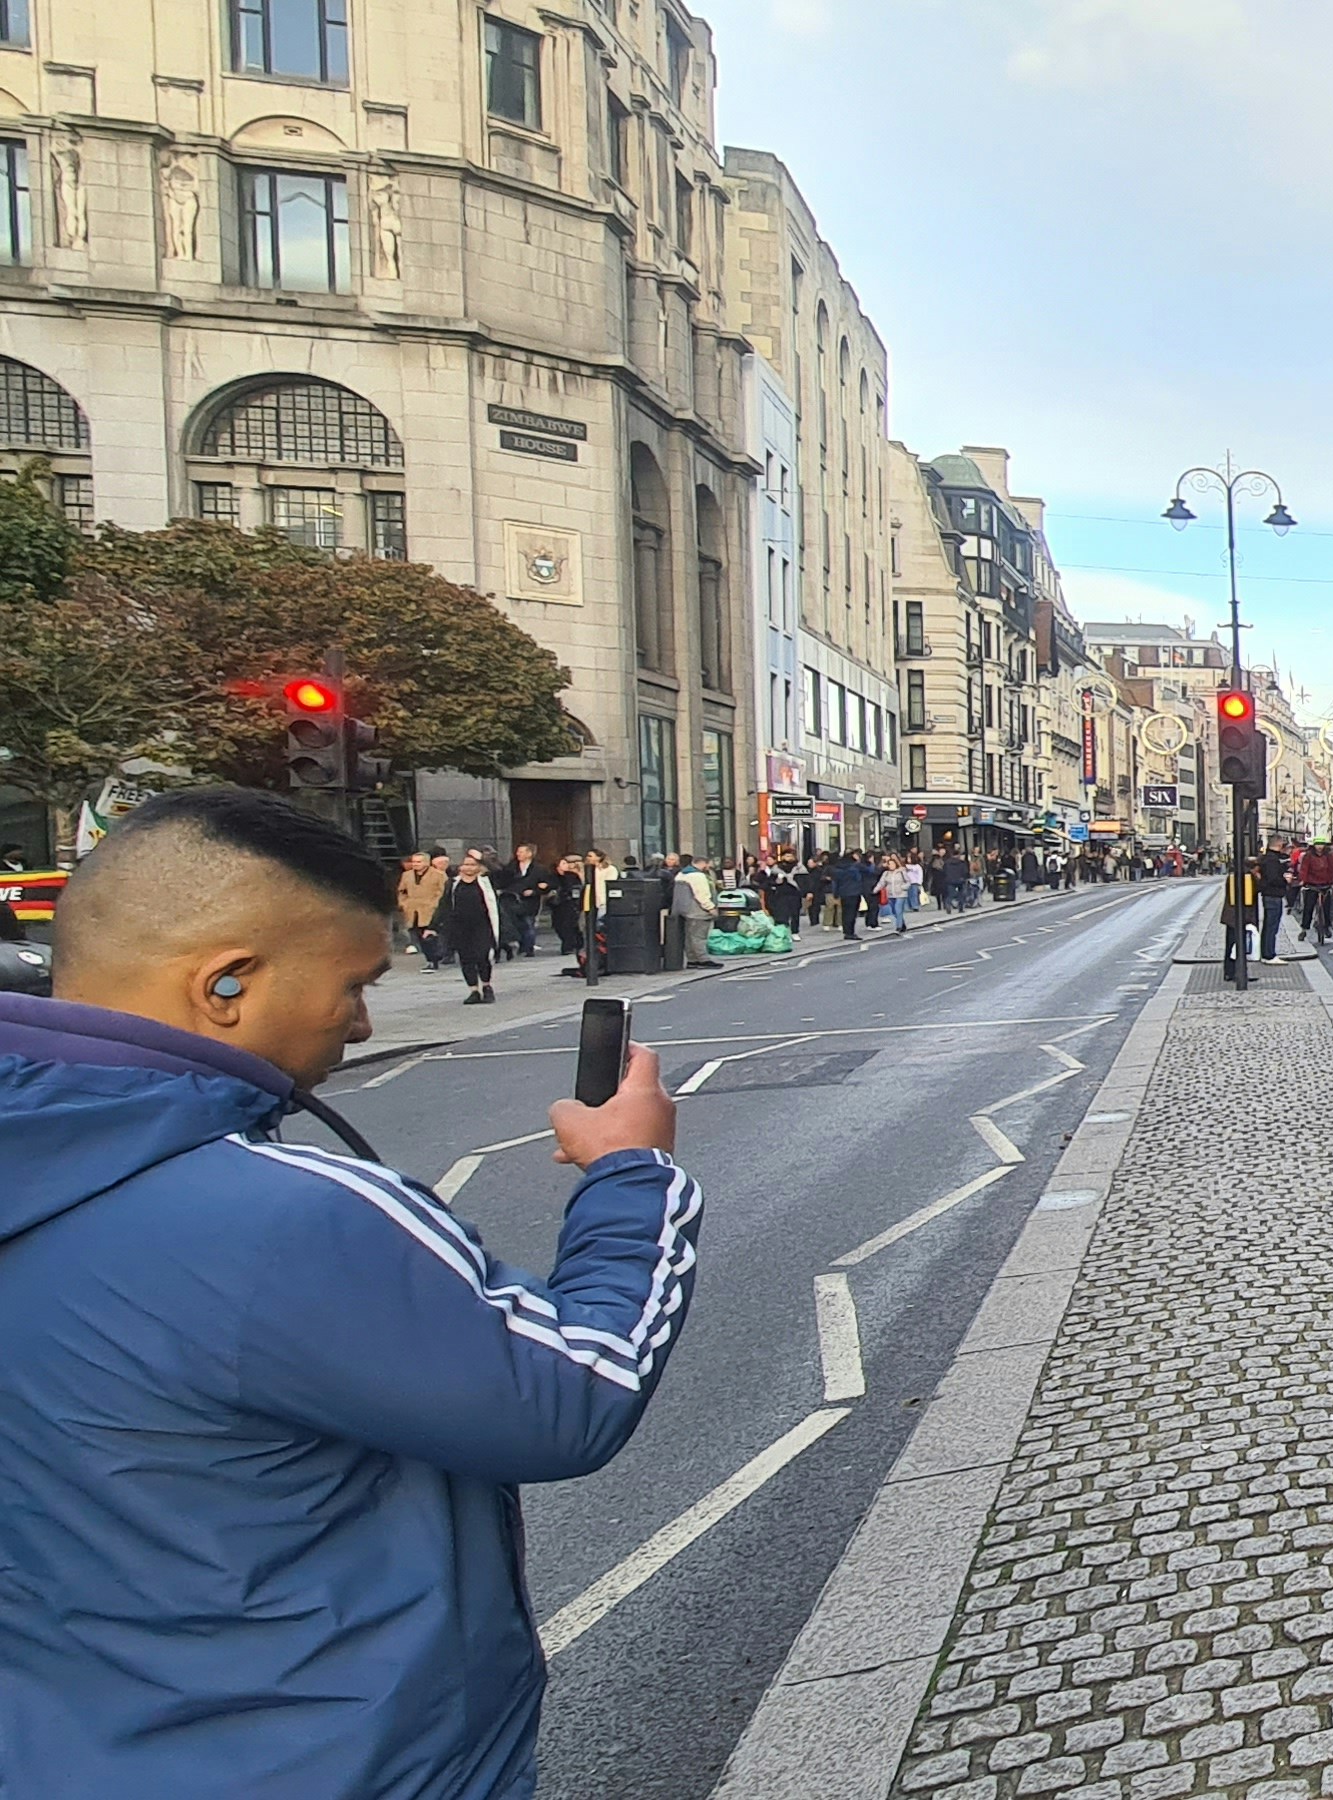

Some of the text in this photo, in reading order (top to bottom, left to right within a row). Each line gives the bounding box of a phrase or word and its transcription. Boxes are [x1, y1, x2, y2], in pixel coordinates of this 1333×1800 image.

[491, 408, 584, 437] ZIMBABWE
[512, 435, 567, 456] HOUSE
[1149, 791, 1171, 803] SIX
